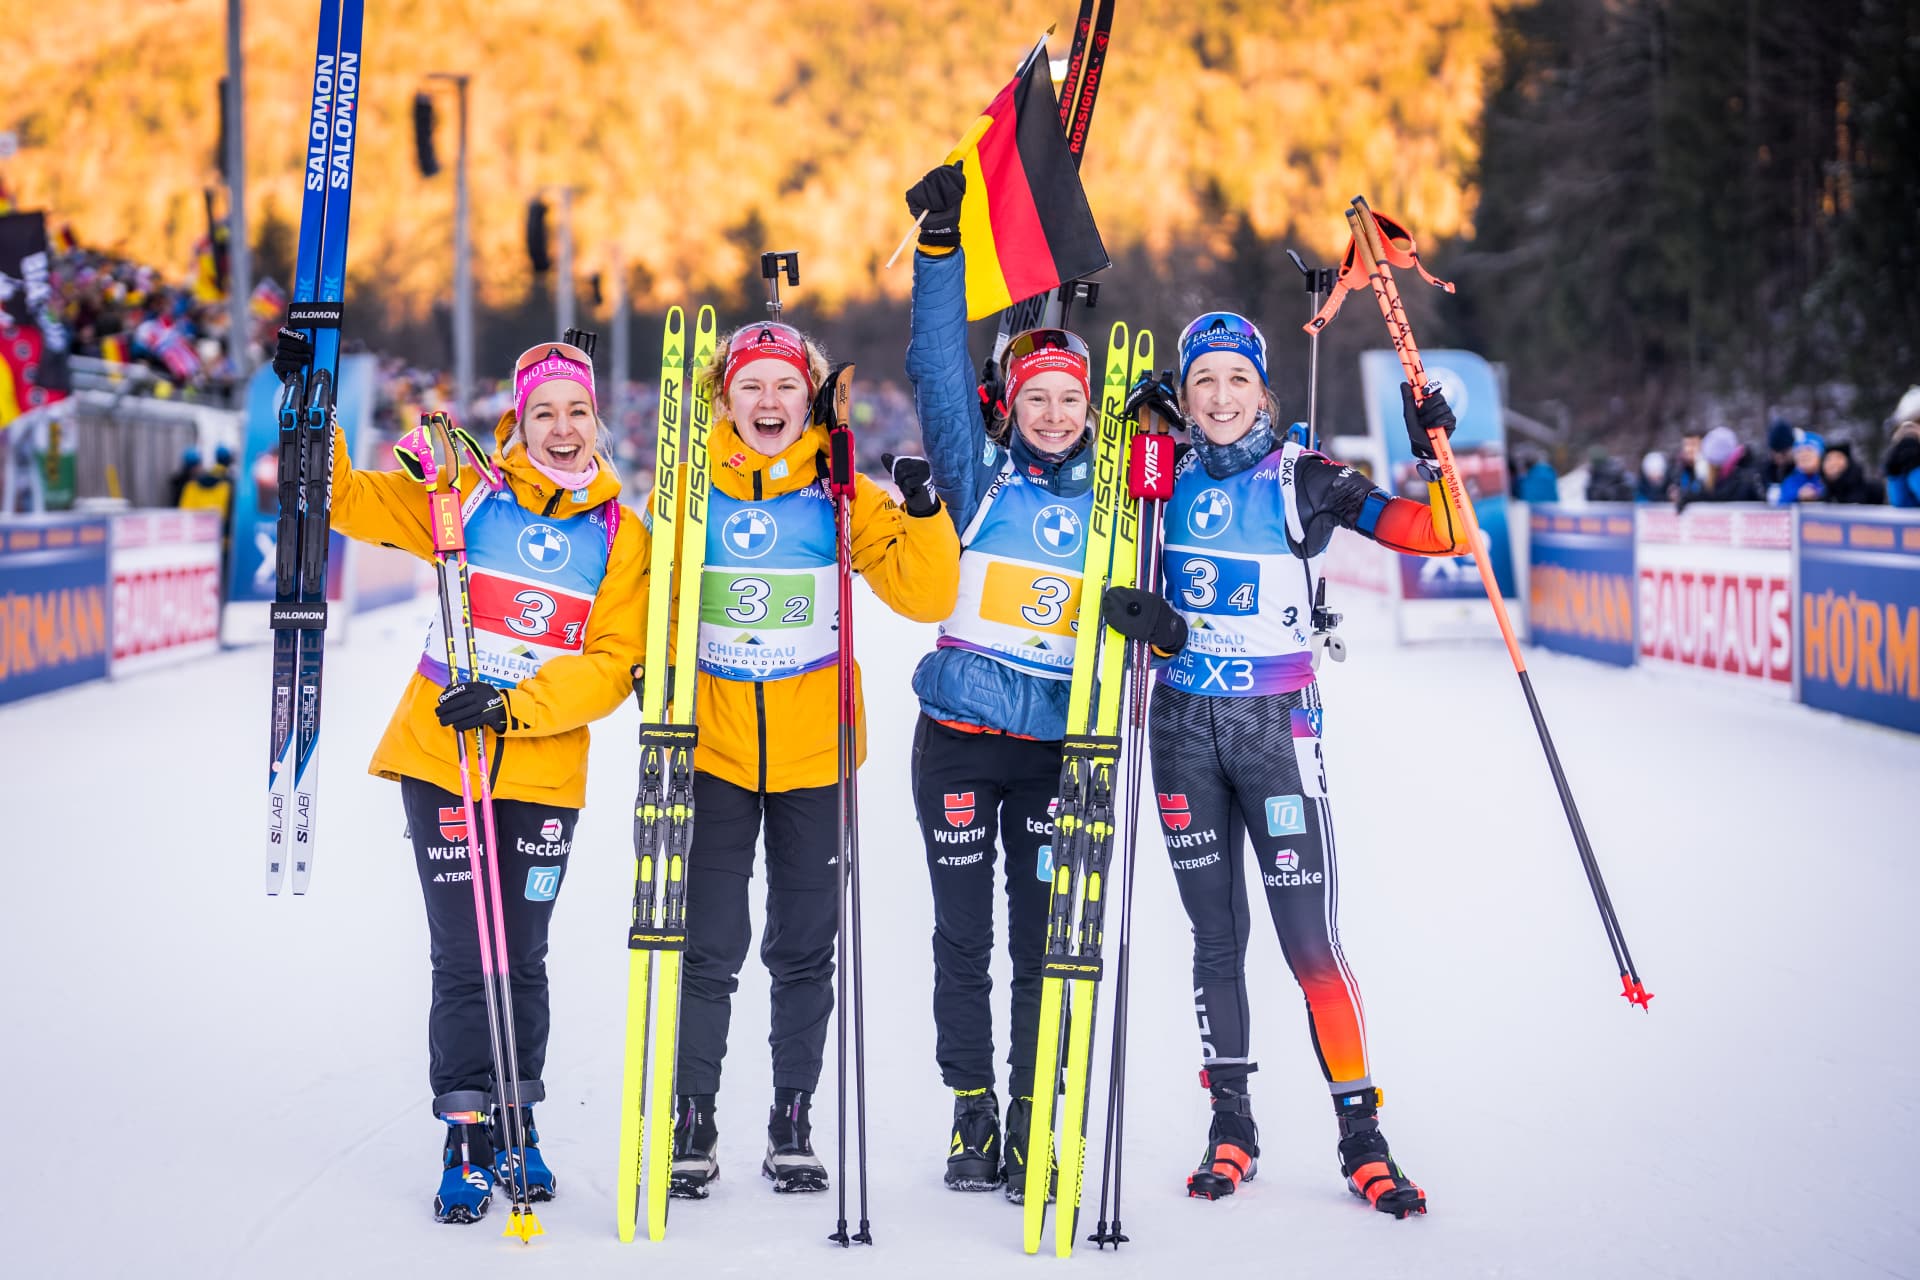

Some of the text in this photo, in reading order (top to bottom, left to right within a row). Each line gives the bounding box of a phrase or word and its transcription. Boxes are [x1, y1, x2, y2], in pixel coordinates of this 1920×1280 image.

[307, 54, 334, 192] SALOMON
[331, 51, 358, 190] SALOMON
[1069, 65, 1100, 154] ROSSIGNOL
[290, 311, 340, 320] SALOMON
[326, 403, 338, 513] SALOMON
[658, 378, 679, 523] FISCHER
[1093, 396, 1120, 538] FISCHER
[1281, 457, 1295, 487] JOKA
[441, 498, 455, 545] LEKI
[731, 511, 771, 525] BMW
[1042, 508, 1079, 526] BMW
[527, 526, 566, 543] BMW
[1181, 558, 1255, 611] 3 4
[273, 611, 325, 620] SALOMON
[725, 577, 771, 624] 3
[780, 596, 810, 625] 2
[1021, 576, 1071, 627] 3
[504, 590, 581, 644] 3 1
[1282, 606, 1298, 627] 3
[1641, 568, 1792, 683] BAUHAUS
[708, 641, 797, 659] CHIEMGAU
[1166, 657, 1255, 692] NEW X3
[1064, 742, 1119, 751] FISCHER
[1270, 801, 1300, 830] TQ
[948, 851, 984, 866] TERREX
[1181, 851, 1221, 870] TERREX
[533, 871, 554, 897] TQ
[1264, 868, 1323, 887] tectake
[1045, 962, 1099, 973] FISCHER
